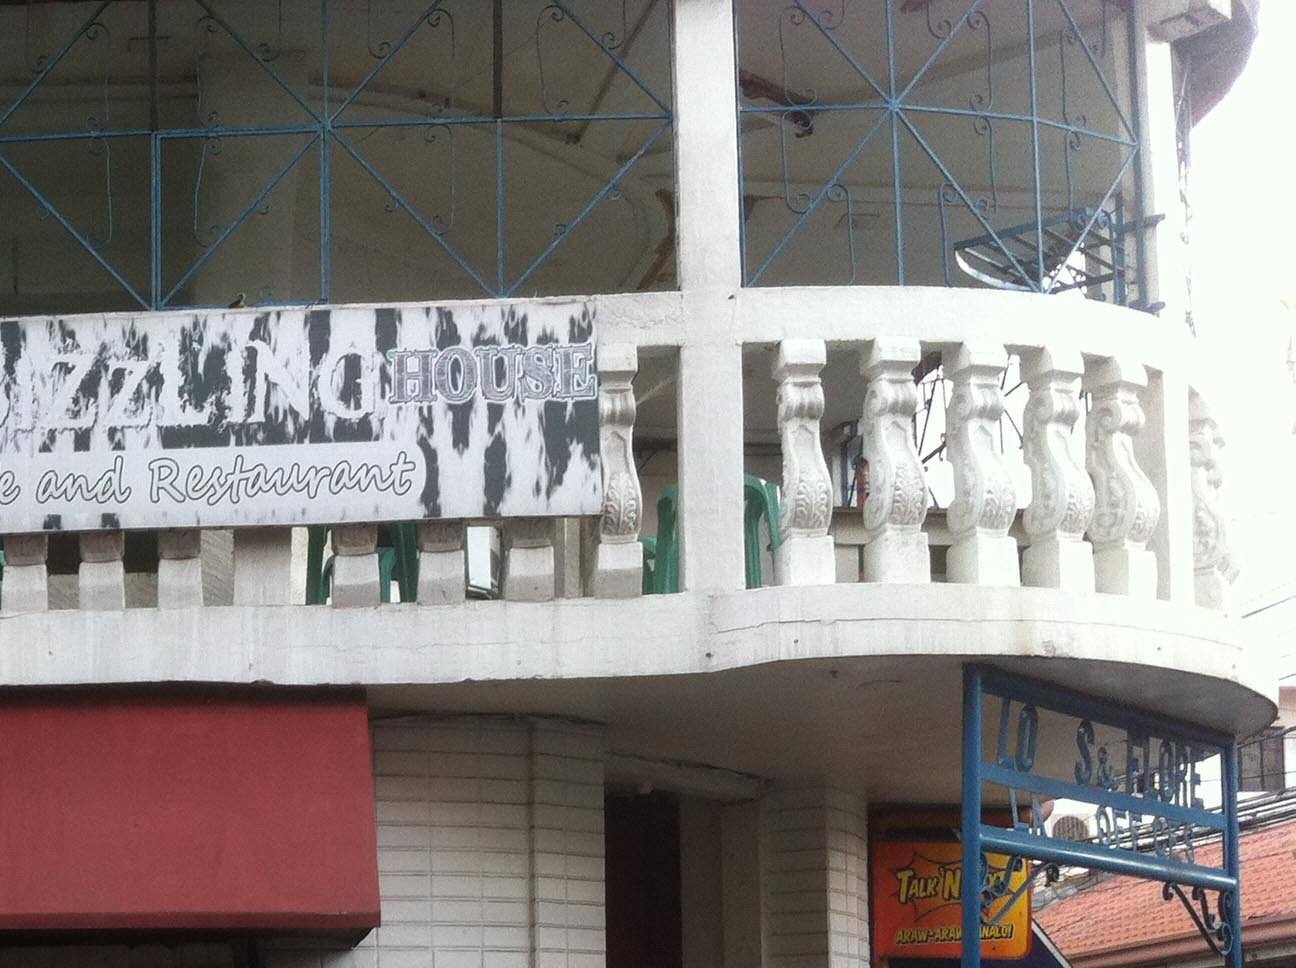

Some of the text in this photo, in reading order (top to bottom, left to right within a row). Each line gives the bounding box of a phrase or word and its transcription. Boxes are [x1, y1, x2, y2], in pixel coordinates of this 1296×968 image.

[388, 344, 599, 404] HOUSE
[35, 455, 133, 505] and
[148, 451, 416, 506] Restaurant
